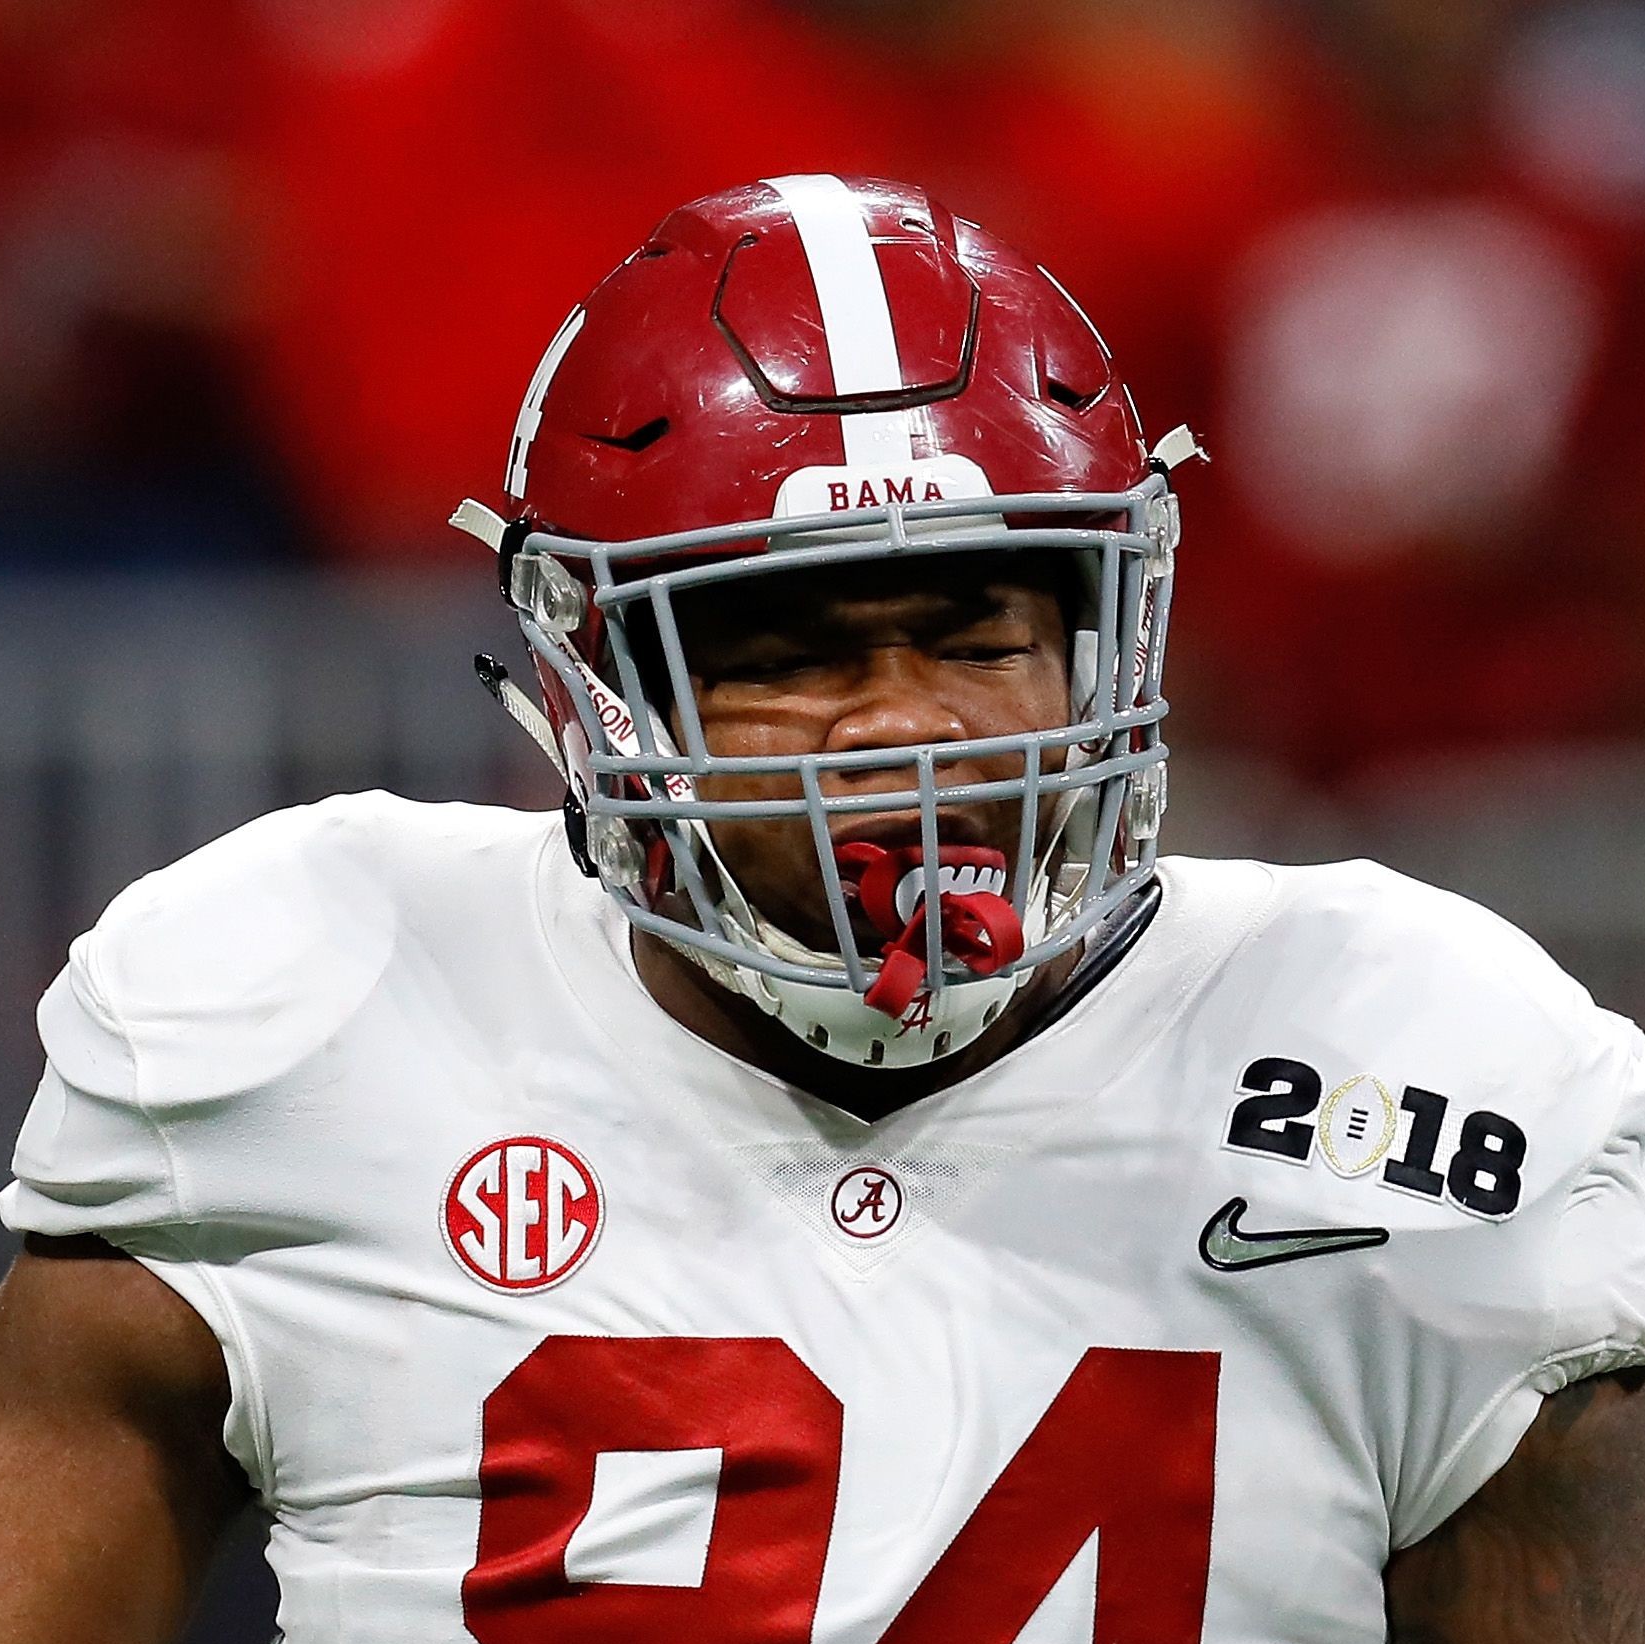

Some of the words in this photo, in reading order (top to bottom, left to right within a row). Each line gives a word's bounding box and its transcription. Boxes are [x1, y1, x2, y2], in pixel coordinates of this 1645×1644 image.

[827, 476, 945, 512] BAMA
[456, 1145, 589, 1281] SEC
[840, 1177, 885, 1223] A
